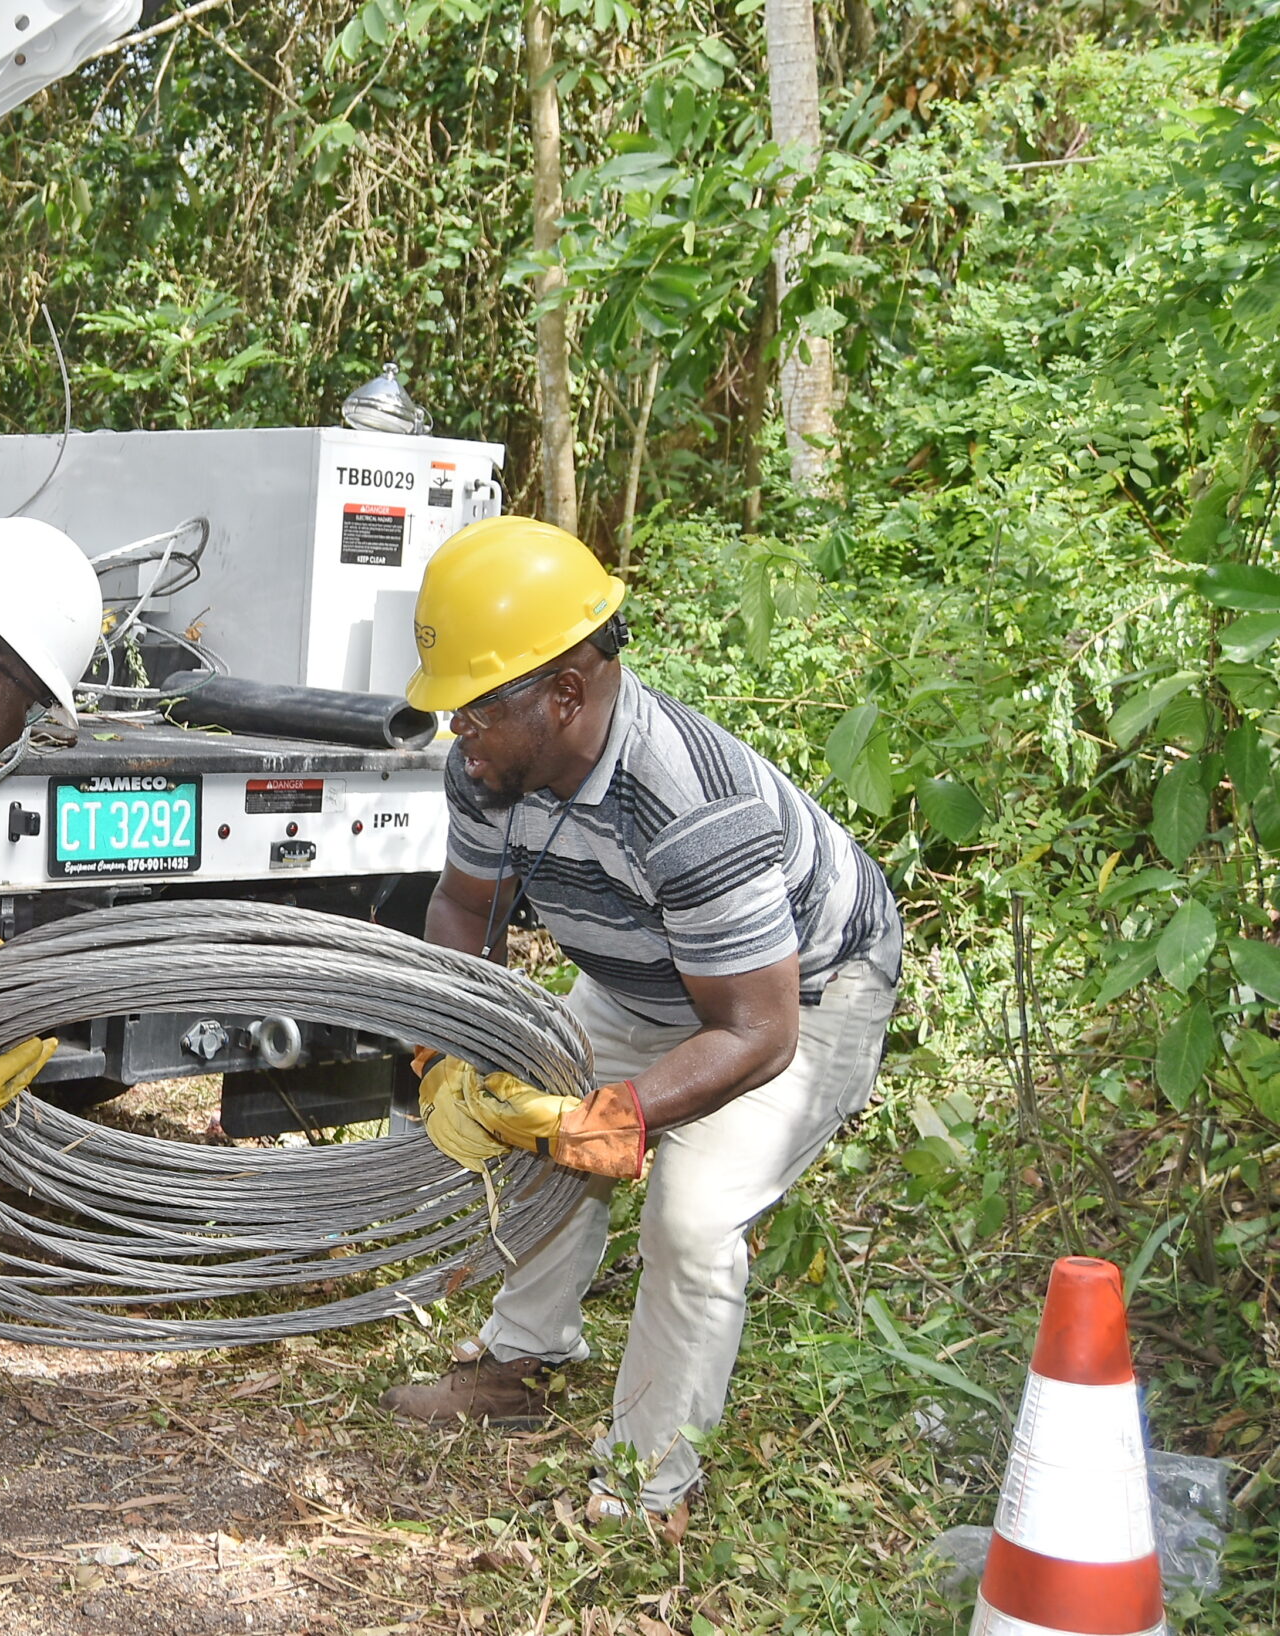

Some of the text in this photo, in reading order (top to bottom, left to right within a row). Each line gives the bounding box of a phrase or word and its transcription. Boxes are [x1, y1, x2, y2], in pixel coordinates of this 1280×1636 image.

[336, 467, 415, 490] TBB0029
[365, 505, 390, 514] DANGER
[357, 555, 386, 564] KEEP CLEAR
[89, 776, 166, 791] JAMECO
[272, 780, 304, 790] DANGER
[62, 802, 102, 850] CT
[110, 800, 191, 849] 3292
[373, 813, 409, 828] IPM
[64, 861, 96, 875] Equipment
